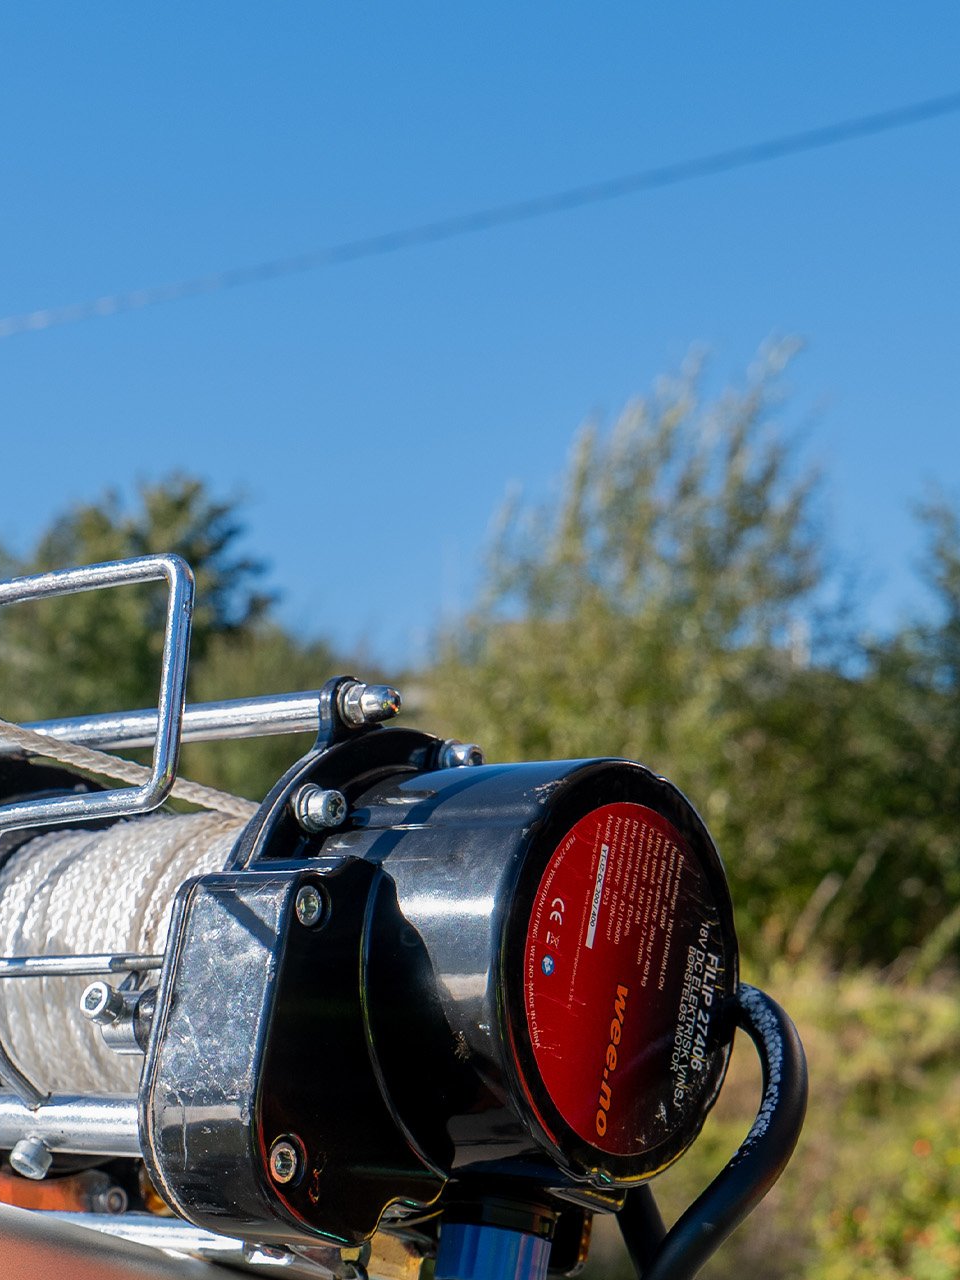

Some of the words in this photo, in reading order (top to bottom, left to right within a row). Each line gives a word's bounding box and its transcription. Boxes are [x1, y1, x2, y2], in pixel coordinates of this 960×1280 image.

[694, 950, 705, 973] DC
[698, 922, 710, 949] 18V
[678, 945, 698, 1022] BØRSTELØS
[702, 952, 719, 1007] FILIP
[680, 976, 702, 1060] ELEKTRISK
[691, 1009, 710, 1071] 27406
[596, 984, 628, 1137] wee.no
[670, 1024, 684, 1072] MOTOR
[673, 1064, 688, 1108] VINSJ
